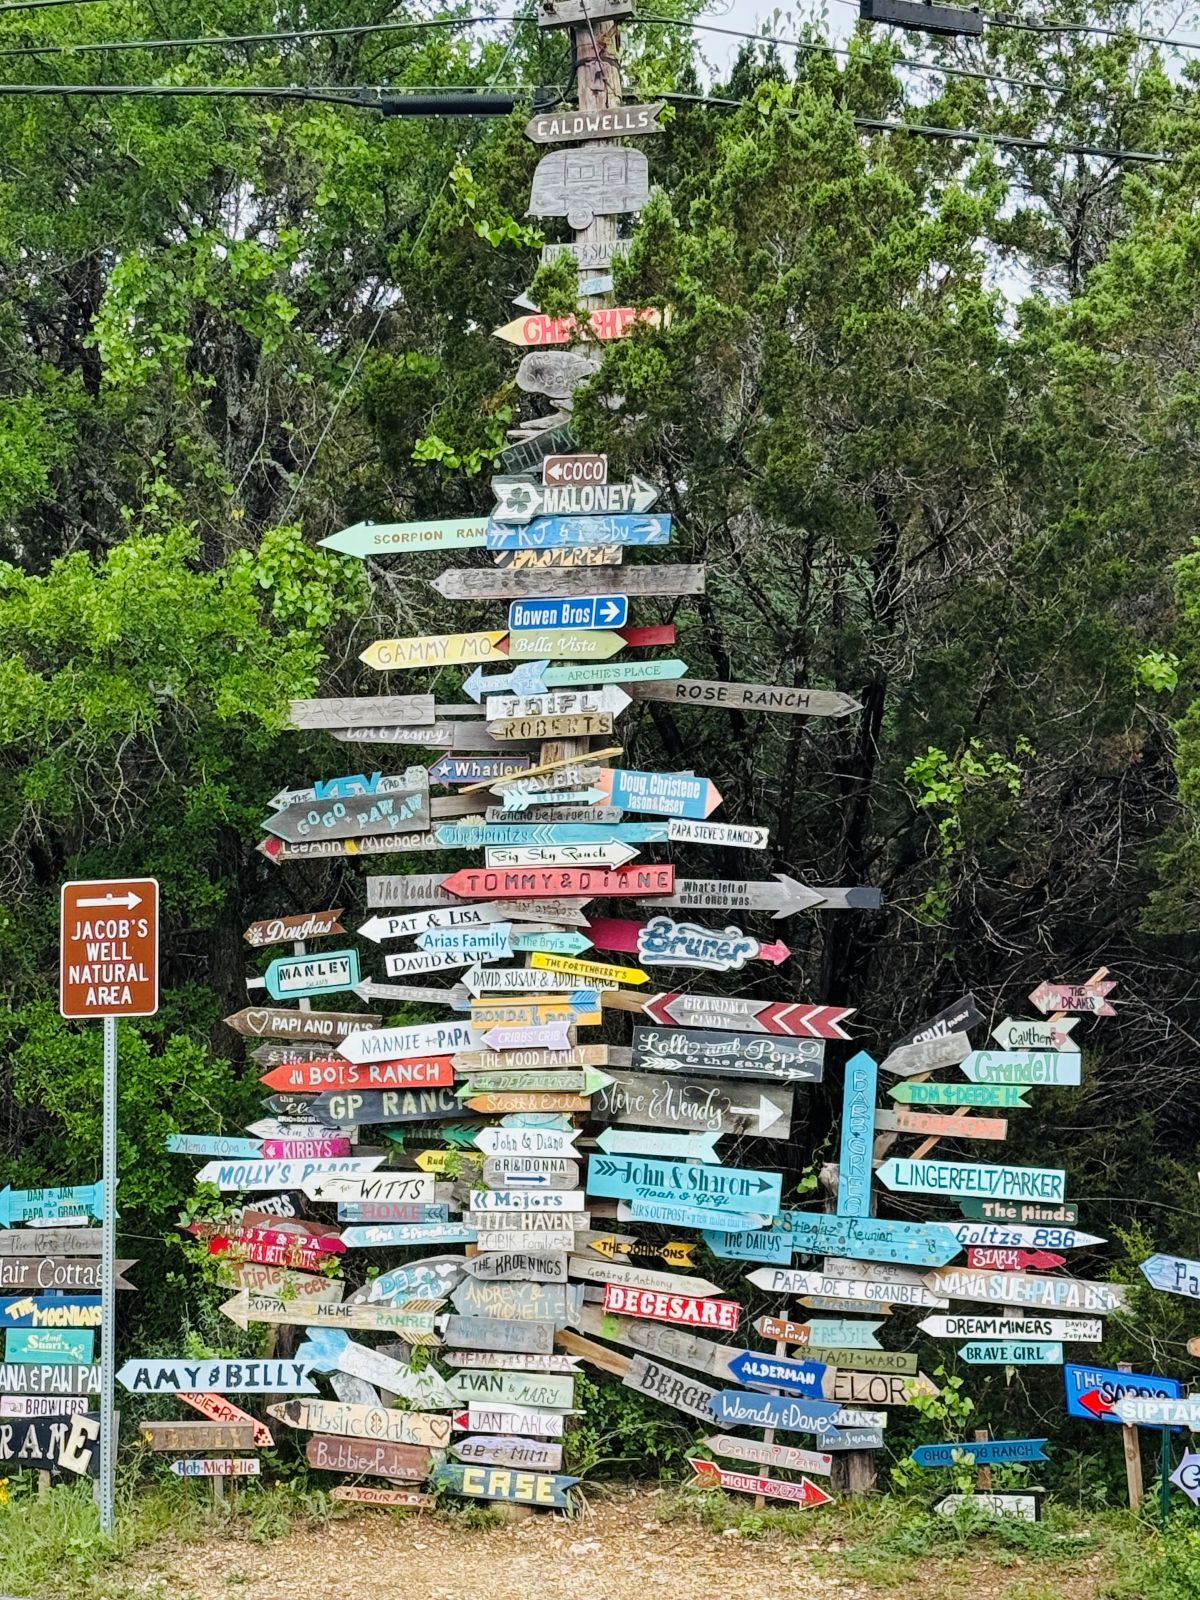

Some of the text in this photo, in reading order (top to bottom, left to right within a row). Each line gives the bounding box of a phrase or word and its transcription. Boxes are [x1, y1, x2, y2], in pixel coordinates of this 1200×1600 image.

[536, 111, 649, 136] CALDWELLS
[563, 461, 602, 480] COCO
[543, 484, 632, 513] MALONEY
[374, 530, 443, 545] SCORPION
[518, 521, 552, 546] KJ
[514, 603, 590, 626] Bowen Bros
[377, 639, 450, 664] GAMMY
[515, 636, 597, 652] Bella Vista
[567, 665, 662, 681] ARCHIE'S PLACE
[676, 684, 811, 708] ROSE RANCH
[504, 715, 611, 738] ROBERTS
[455, 760, 523, 777] Whatley
[619, 771, 700, 800] Doug, Christene
[357, 799, 394, 830] PAW
[671, 824, 753, 843] PAPA STEVE'S RANCH
[527, 847, 556, 863] Sky
[467, 872, 553, 891] TOMMY
[682, 881, 747, 893] What's left of
[680, 893, 728, 906] what once
[71, 918, 149, 941] JACOB'S
[86, 941, 133, 962] WELL
[423, 932, 507, 950] Arias Family
[642, 919, 751, 963] Bruner
[279, 960, 350, 981] MANLEY
[545, 957, 561, 968] THE
[68, 962, 149, 985] NATURAL
[85, 985, 133, 1006] AREA
[1068, 986, 1087, 997] THE
[683, 997, 749, 1015] GRANDMA
[271, 1017, 301, 1032] PAPI
[303, 1020, 334, 1034] AND
[538, 1030, 561, 1042] CRIB
[361, 1027, 471, 1055] NANNIE PAPA
[638, 1033, 701, 1056] Lolli
[479, 1048, 586, 1068] THE WOOD FAMILY
[369, 1062, 440, 1085] RANCH
[908, 1085, 941, 1101] TOM
[330, 1094, 363, 1120] GP
[282, 1140, 333, 1159] KIRBYS
[493, 1131, 564, 1151] John & Diane
[217, 1163, 291, 1185] MOLLY'S
[524, 1159, 566, 1172] DONNA
[360, 1179, 425, 1200] WITTS
[620, 1161, 751, 1197] John & Sharon
[894, 1162, 1063, 1200] LINGERFELT/PARKER
[27, 1187, 74, 1202] DAN JAN
[635, 1187, 675, 1201] Noah
[361, 1202, 419, 1219] HOME
[982, 1203, 1076, 1222] The Hinds
[521, 1212, 574, 1231] HAVEN
[955, 1225, 1076, 1249] Goltzs 836
[601, 1241, 686, 1260] THE JOHNSONS
[972, 1248, 1021, 1270] STARK
[472, 1254, 562, 1276] THE KROENINGS
[588, 1266, 623, 1284] Gentry
[634, 1274, 673, 1292] Anthony
[772, 1271, 840, 1296] PAPA JOE
[934, 1271, 1080, 1308] NANA SUE PAPA
[247, 1298, 354, 1318] POPPA MEME
[607, 1287, 734, 1327] DECESARE
[946, 1318, 1053, 1336] DREAM MINERS
[865, 1354, 908, 1369] WARD
[966, 1346, 1045, 1361] BRAVE GIRL
[41, 1365, 72, 1393] PAW
[133, 1366, 201, 1390] AMY
[226, 1363, 306, 1388] BILLY
[741, 1361, 817, 1385] ALDERMAN
[1074, 1370, 1103, 1392] THE
[457, 1374, 560, 1405] IVAN MARY
[472, 1412, 545, 1435] JAN CARL
[722, 1394, 780, 1428] Wendy
[789, 1405, 831, 1433] Dave
[316, 1441, 369, 1470] Bubbie
[510, 1446, 549, 1463] MIMI
[992, 1444, 1034, 1457] RANCH
[203, 1459, 256, 1476] Michelle
[462, 1467, 557, 1503] CASE
[720, 1473, 764, 1492] MIGUEL
